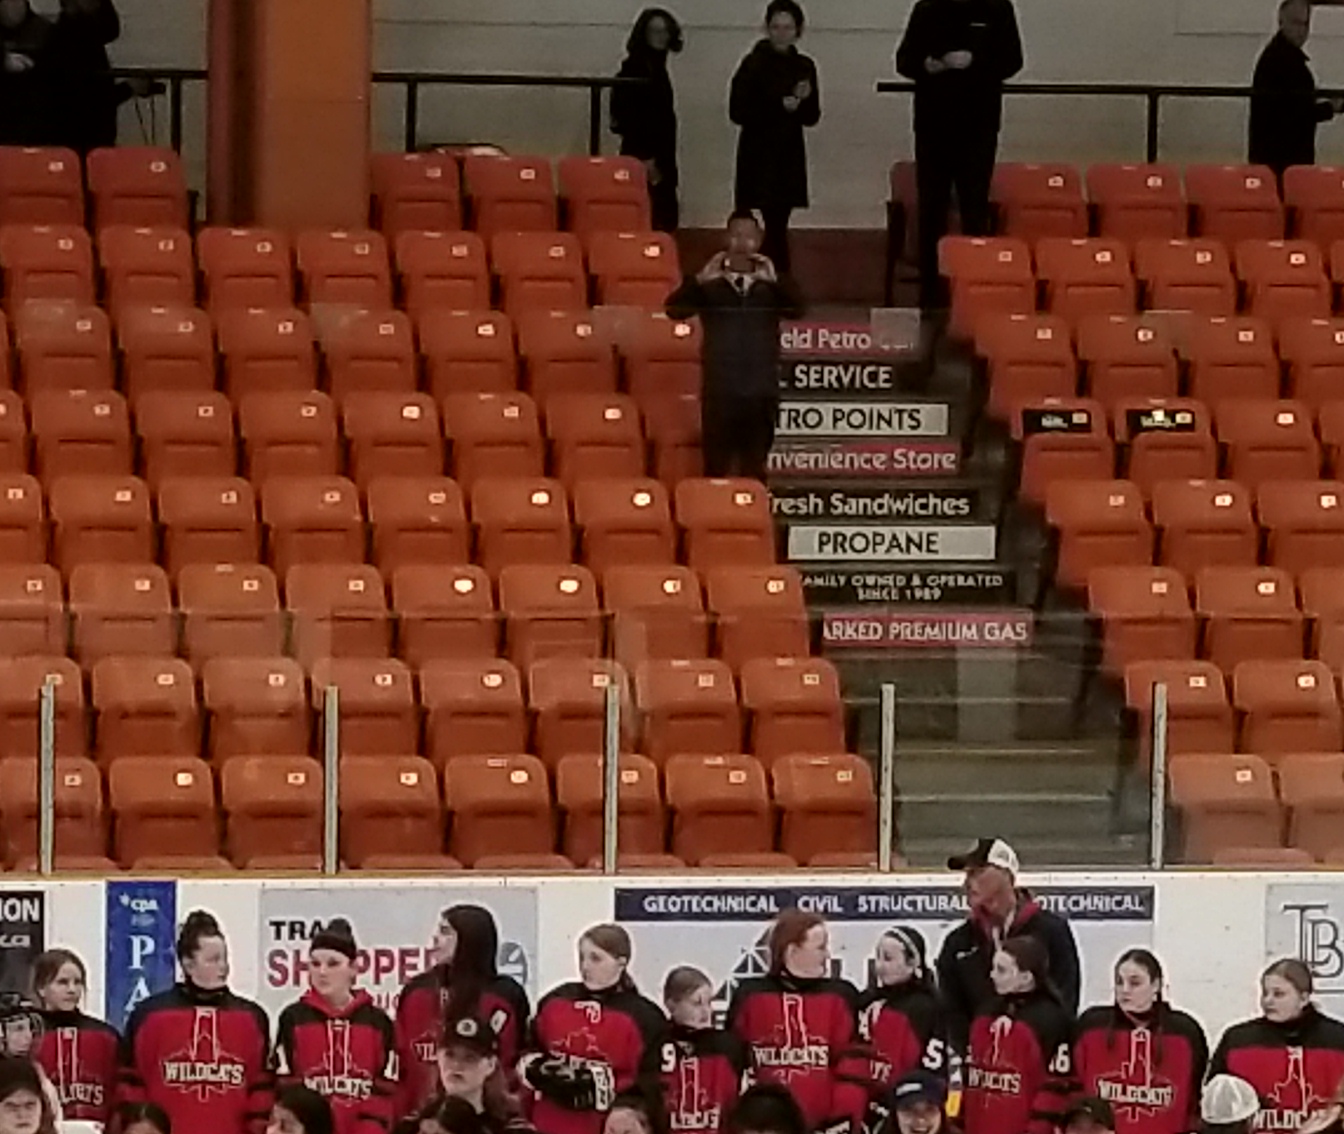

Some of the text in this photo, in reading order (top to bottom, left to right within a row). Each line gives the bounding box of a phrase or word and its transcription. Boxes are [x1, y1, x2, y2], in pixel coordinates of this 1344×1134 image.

[817, 328, 872, 349] Petro
[794, 365, 893, 389] SERVICE
[775, 408, 922, 431] TRO POINTS
[766, 448, 957, 470] nvenience Store
[768, 492, 970, 516] resh Sandwiches
[817, 531, 940, 554] PROPANE
[926, 574, 1003, 588] OPERATED
[857, 588, 900, 601] SINCE
[823, 621, 1027, 641] ARKED PREMIUM GAS
[643, 896, 780, 914] GEOTECHNICAL
[797, 895, 844, 913] CIVIL
[858, 895, 971, 913] STRUCTURAL
[164, 1061, 244, 1084] WILDCATS
